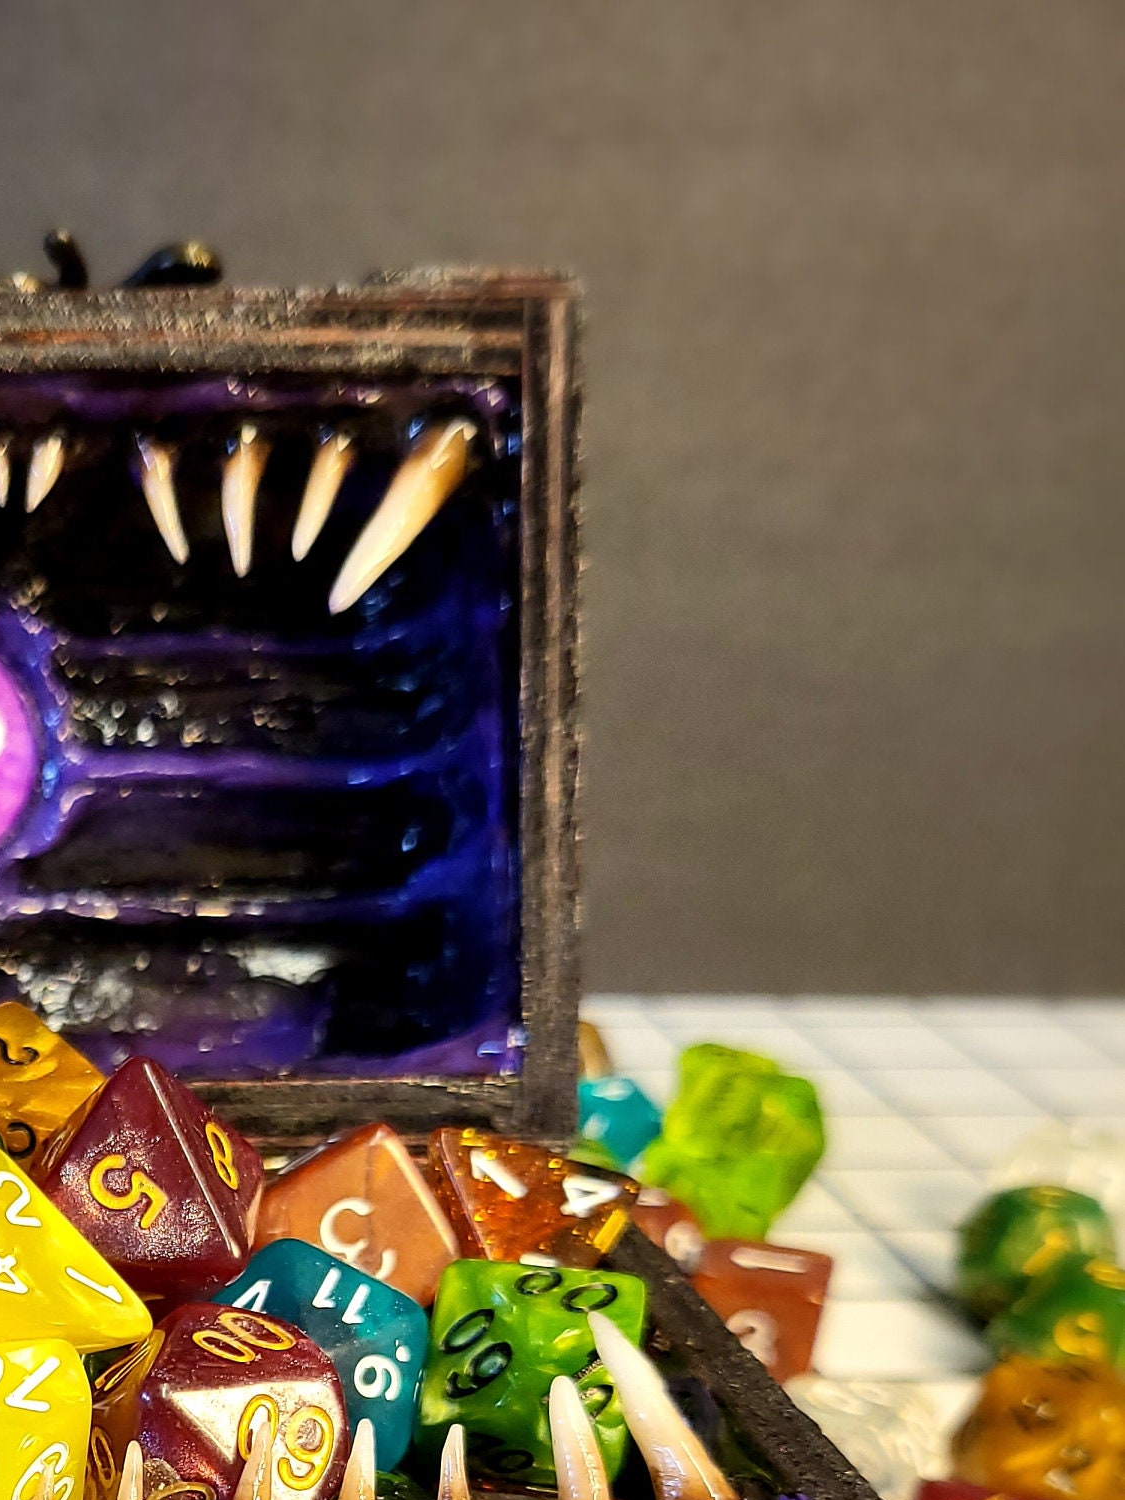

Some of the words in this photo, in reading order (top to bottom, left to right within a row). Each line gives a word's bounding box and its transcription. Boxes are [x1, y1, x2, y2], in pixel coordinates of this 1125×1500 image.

[204, 1122, 240, 1191] 8
[469, 1149, 529, 1199] 1
[88, 1154, 169, 1230] 5
[559, 1174, 623, 1218] 4
[65, 1265, 124, 1304] 1
[311, 1266, 372, 1325] 11
